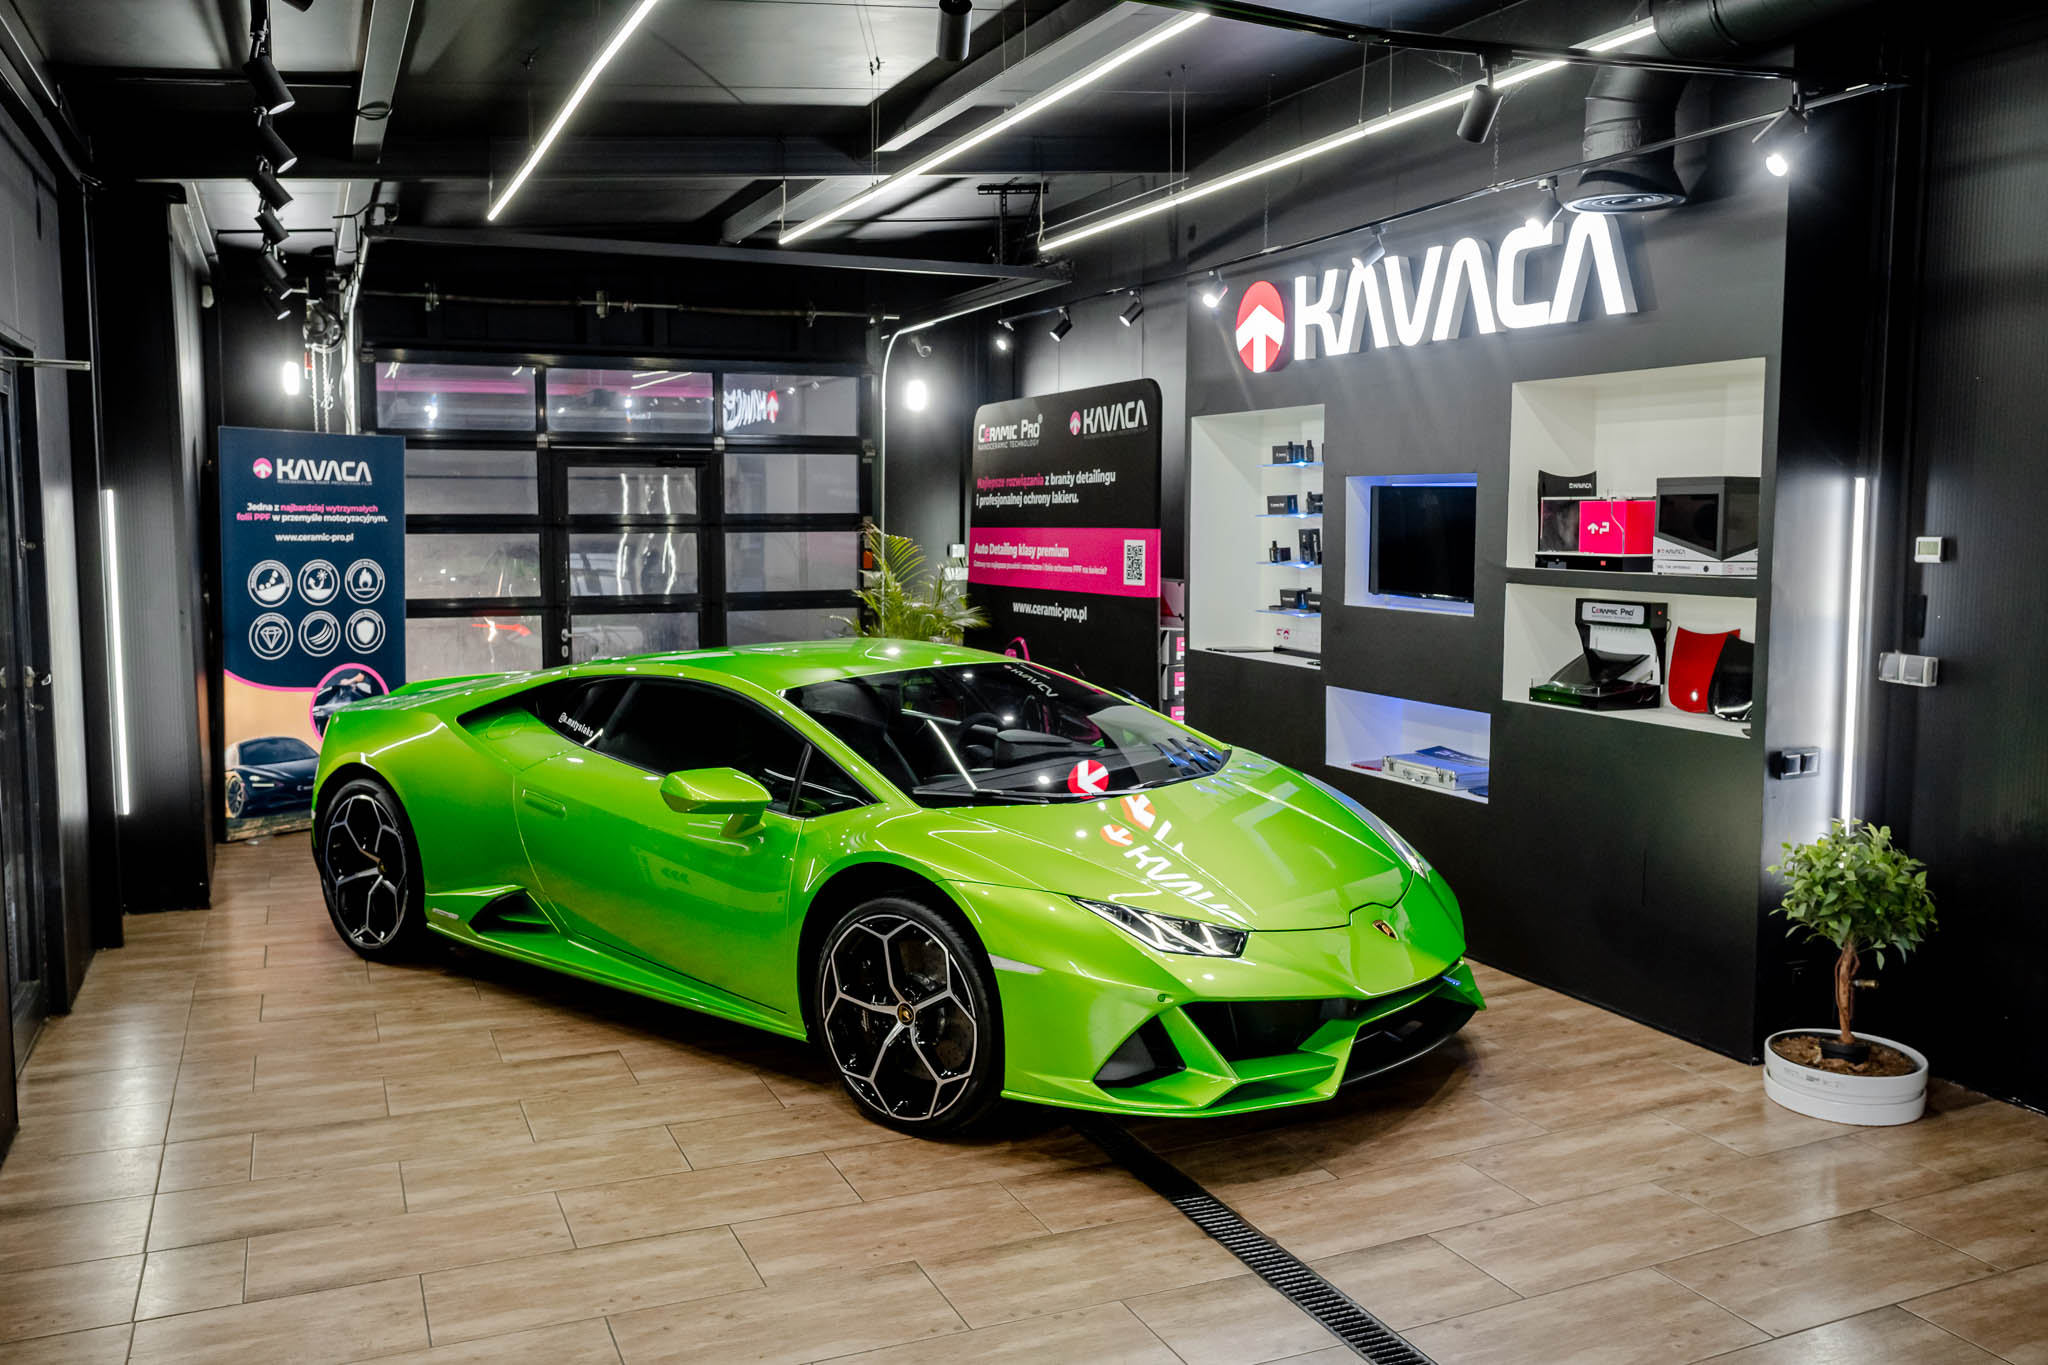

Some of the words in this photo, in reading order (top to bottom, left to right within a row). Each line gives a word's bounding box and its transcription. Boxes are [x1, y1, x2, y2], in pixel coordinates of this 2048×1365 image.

[1293, 211, 1638, 361] KAVACA
[1083, 399, 1149, 435] KAVACA
[276, 457, 373, 482] KAVACA
[1044, 475, 1050, 486] z
[1050, 470, 1075, 487] branży
[1076, 468, 1117, 486] detailingu
[246, 502, 273, 512] Jedna
[274, 504, 280, 512] z
[280, 503, 325, 513] najbardziej
[325, 504, 379, 515] wytrzymałych
[976, 493, 980, 506] i
[979, 491, 1023, 509] profesjonalnej
[1023, 491, 1051, 507] ochrony
[1051, 489, 1080, 504] lakieru.
[253, 512, 271, 521] PPF
[272, 514, 281, 522] w
[323, 513, 389, 525] motoryzacyjnym.
[274, 532, 354, 543] www.ceramic-pro.pl
[974, 542, 989, 555] Auto
[989, 541, 1018, 559] Detailing
[1018, 543, 1037, 560] klasy
[1036, 543, 1070, 560] premium
[1012, 601, 1088, 623] www.ceramic-pro.pl
